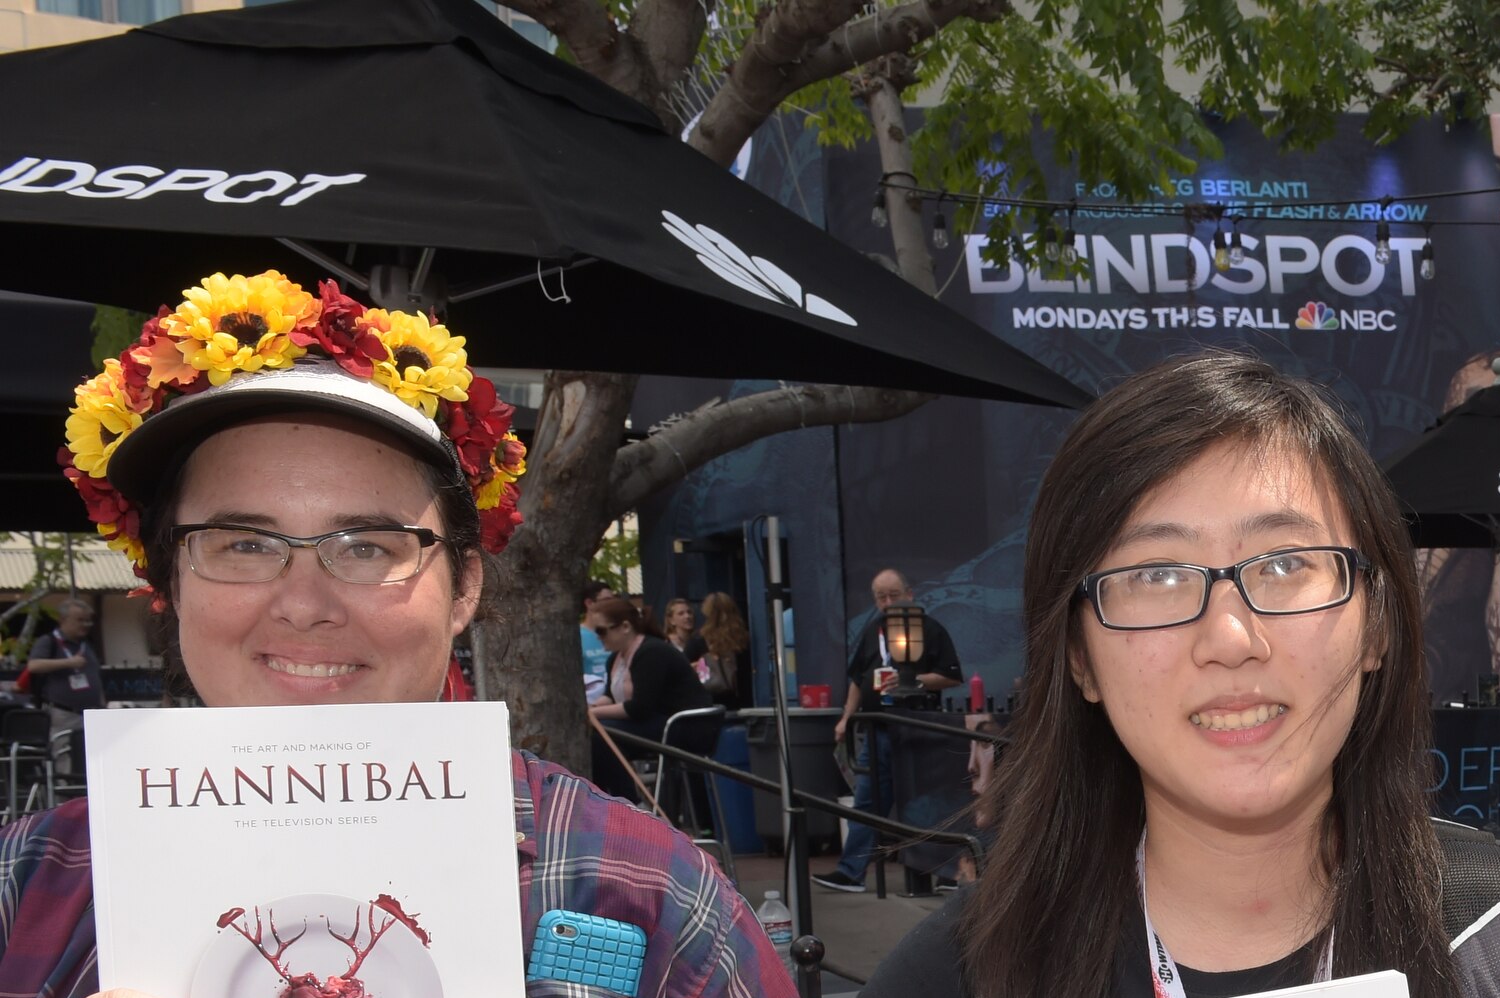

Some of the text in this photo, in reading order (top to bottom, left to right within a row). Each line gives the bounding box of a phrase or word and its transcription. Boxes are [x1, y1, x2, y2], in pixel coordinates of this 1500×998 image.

[1201, 180, 1308, 199] BERLANTI
[1252, 203, 1327, 219] FLASH
[1344, 203, 1428, 221] ARROW
[963, 233, 1431, 296] BLINDSPOT
[1013, 306, 1147, 330] MONDAYS
[1222, 307, 1289, 329] FALL
[1340, 308, 1398, 331] NBC
[232, 742, 372, 753] THE ART AND MAKING OF
[136, 760, 467, 808] HANNIBAL
[234, 816, 378, 829] THE TELEVISION SERIES
